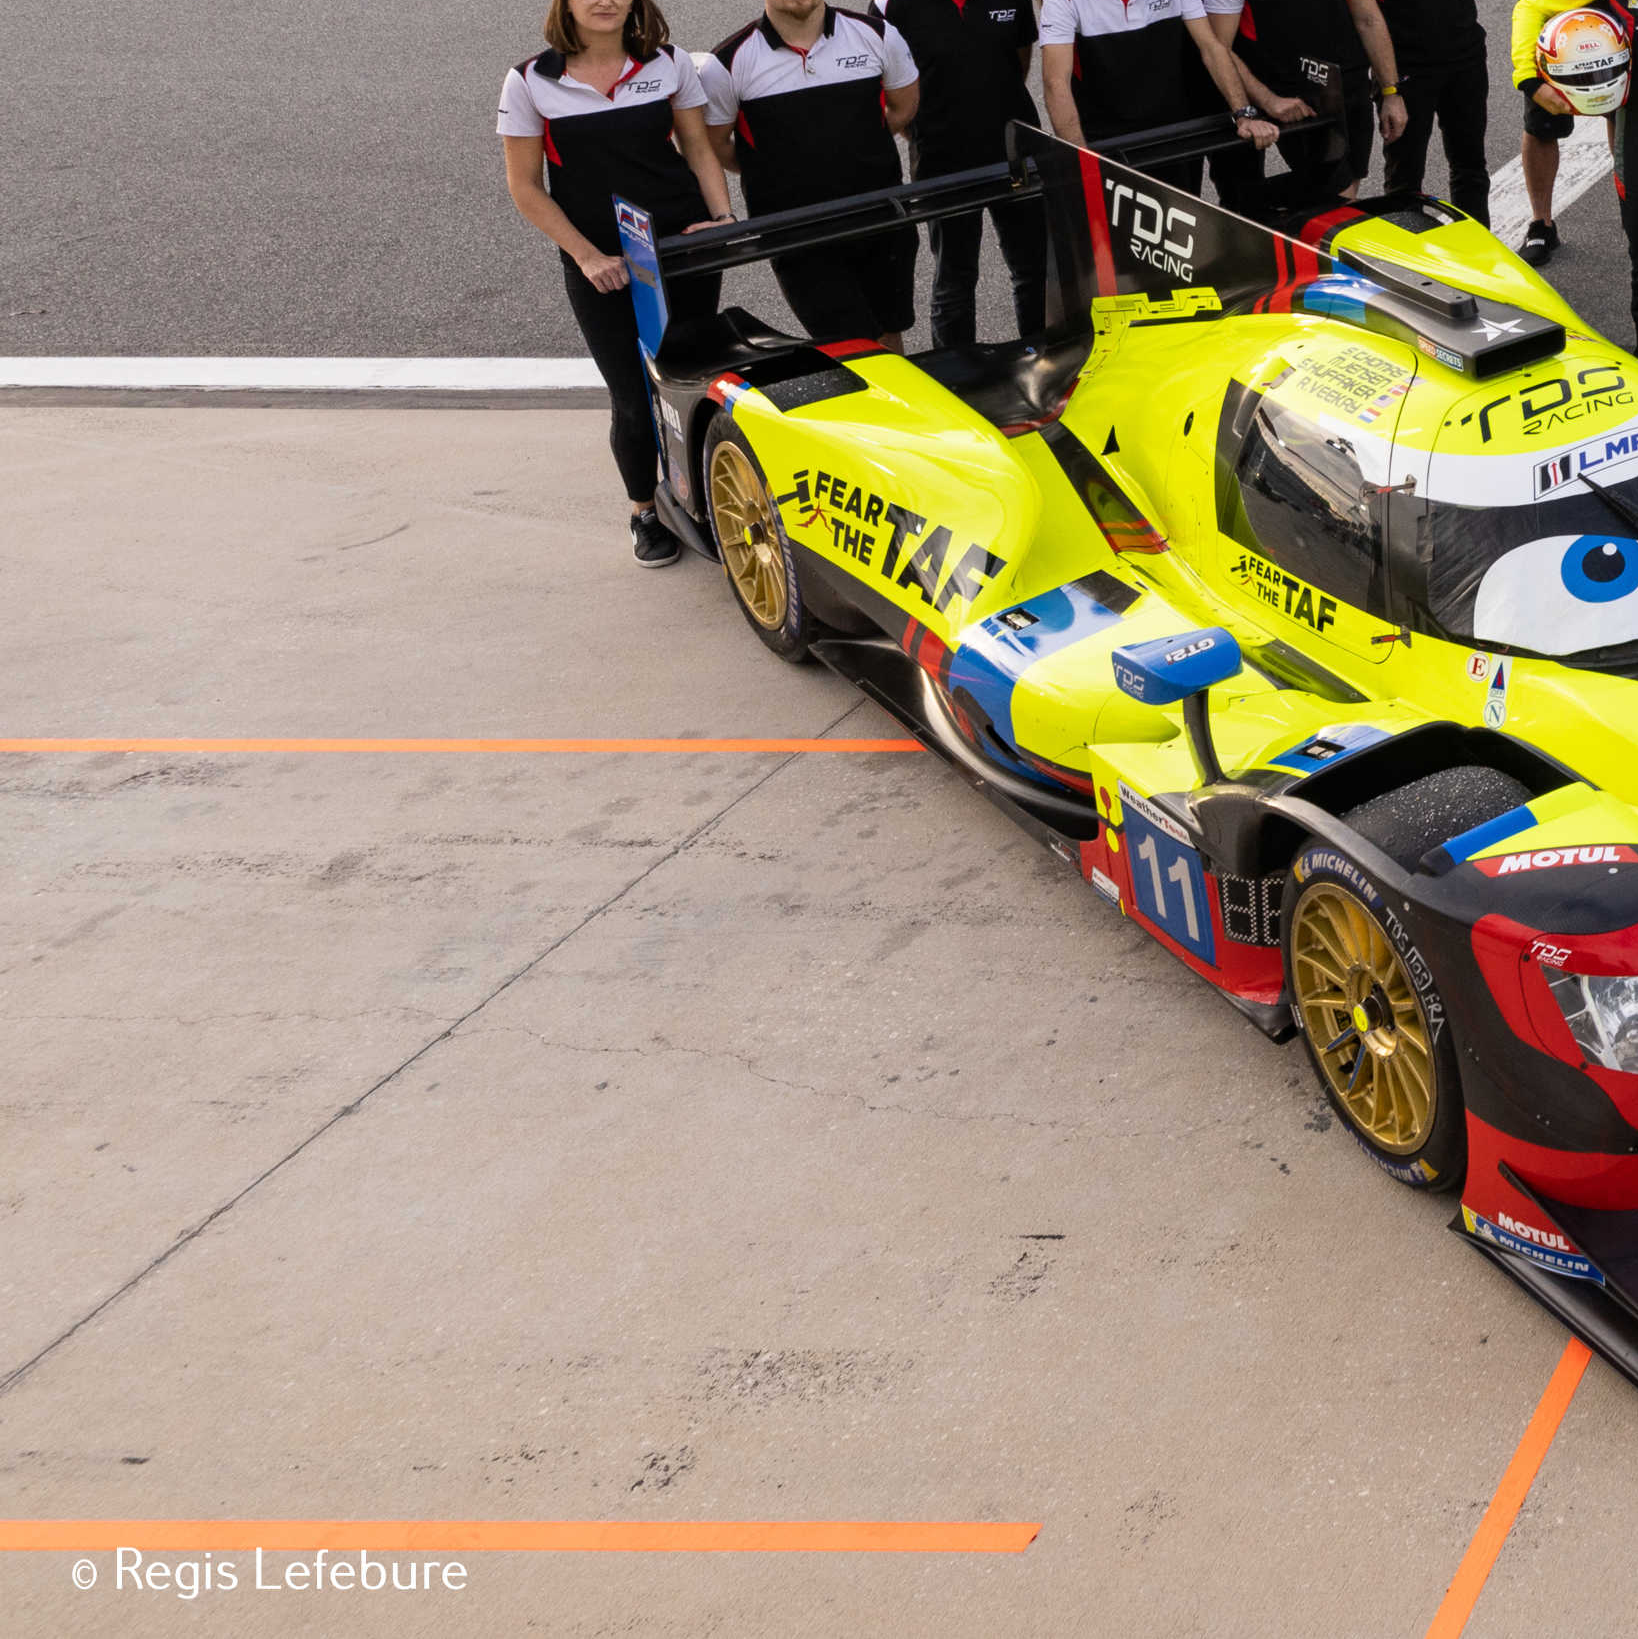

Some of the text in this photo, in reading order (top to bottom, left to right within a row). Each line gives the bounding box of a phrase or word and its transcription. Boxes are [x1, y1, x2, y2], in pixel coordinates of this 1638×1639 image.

[834, 54, 869, 67] TDS
[1578, 42, 1600, 52] BELL
[1593, 57, 1614, 72] TAF
[1106, 178, 1197, 260] TDS
[1130, 237, 1193, 283] RACING
[1461, 363, 1625, 444] TDS
[1522, 391, 1635, 436] RACING
[814, 470, 885, 528] FEAR
[831, 516, 876, 566] THE
[880, 502, 1006, 614] TAF
[1248, 556, 1282, 587] FEAR
[1256, 584, 1280, 608] THE
[1281, 575, 1337, 633] TAF
[1471, 657, 1486, 677] E
[1311, 853, 1380, 903] MICHELIN
[1497, 846, 1620, 875] MOTUL
[1138, 833, 1201, 943] 11
[1531, 940, 1572, 962] TDS
[1497, 1212, 1570, 1252] MOTUL
[1499, 1234, 1590, 1273] MICHELIN
